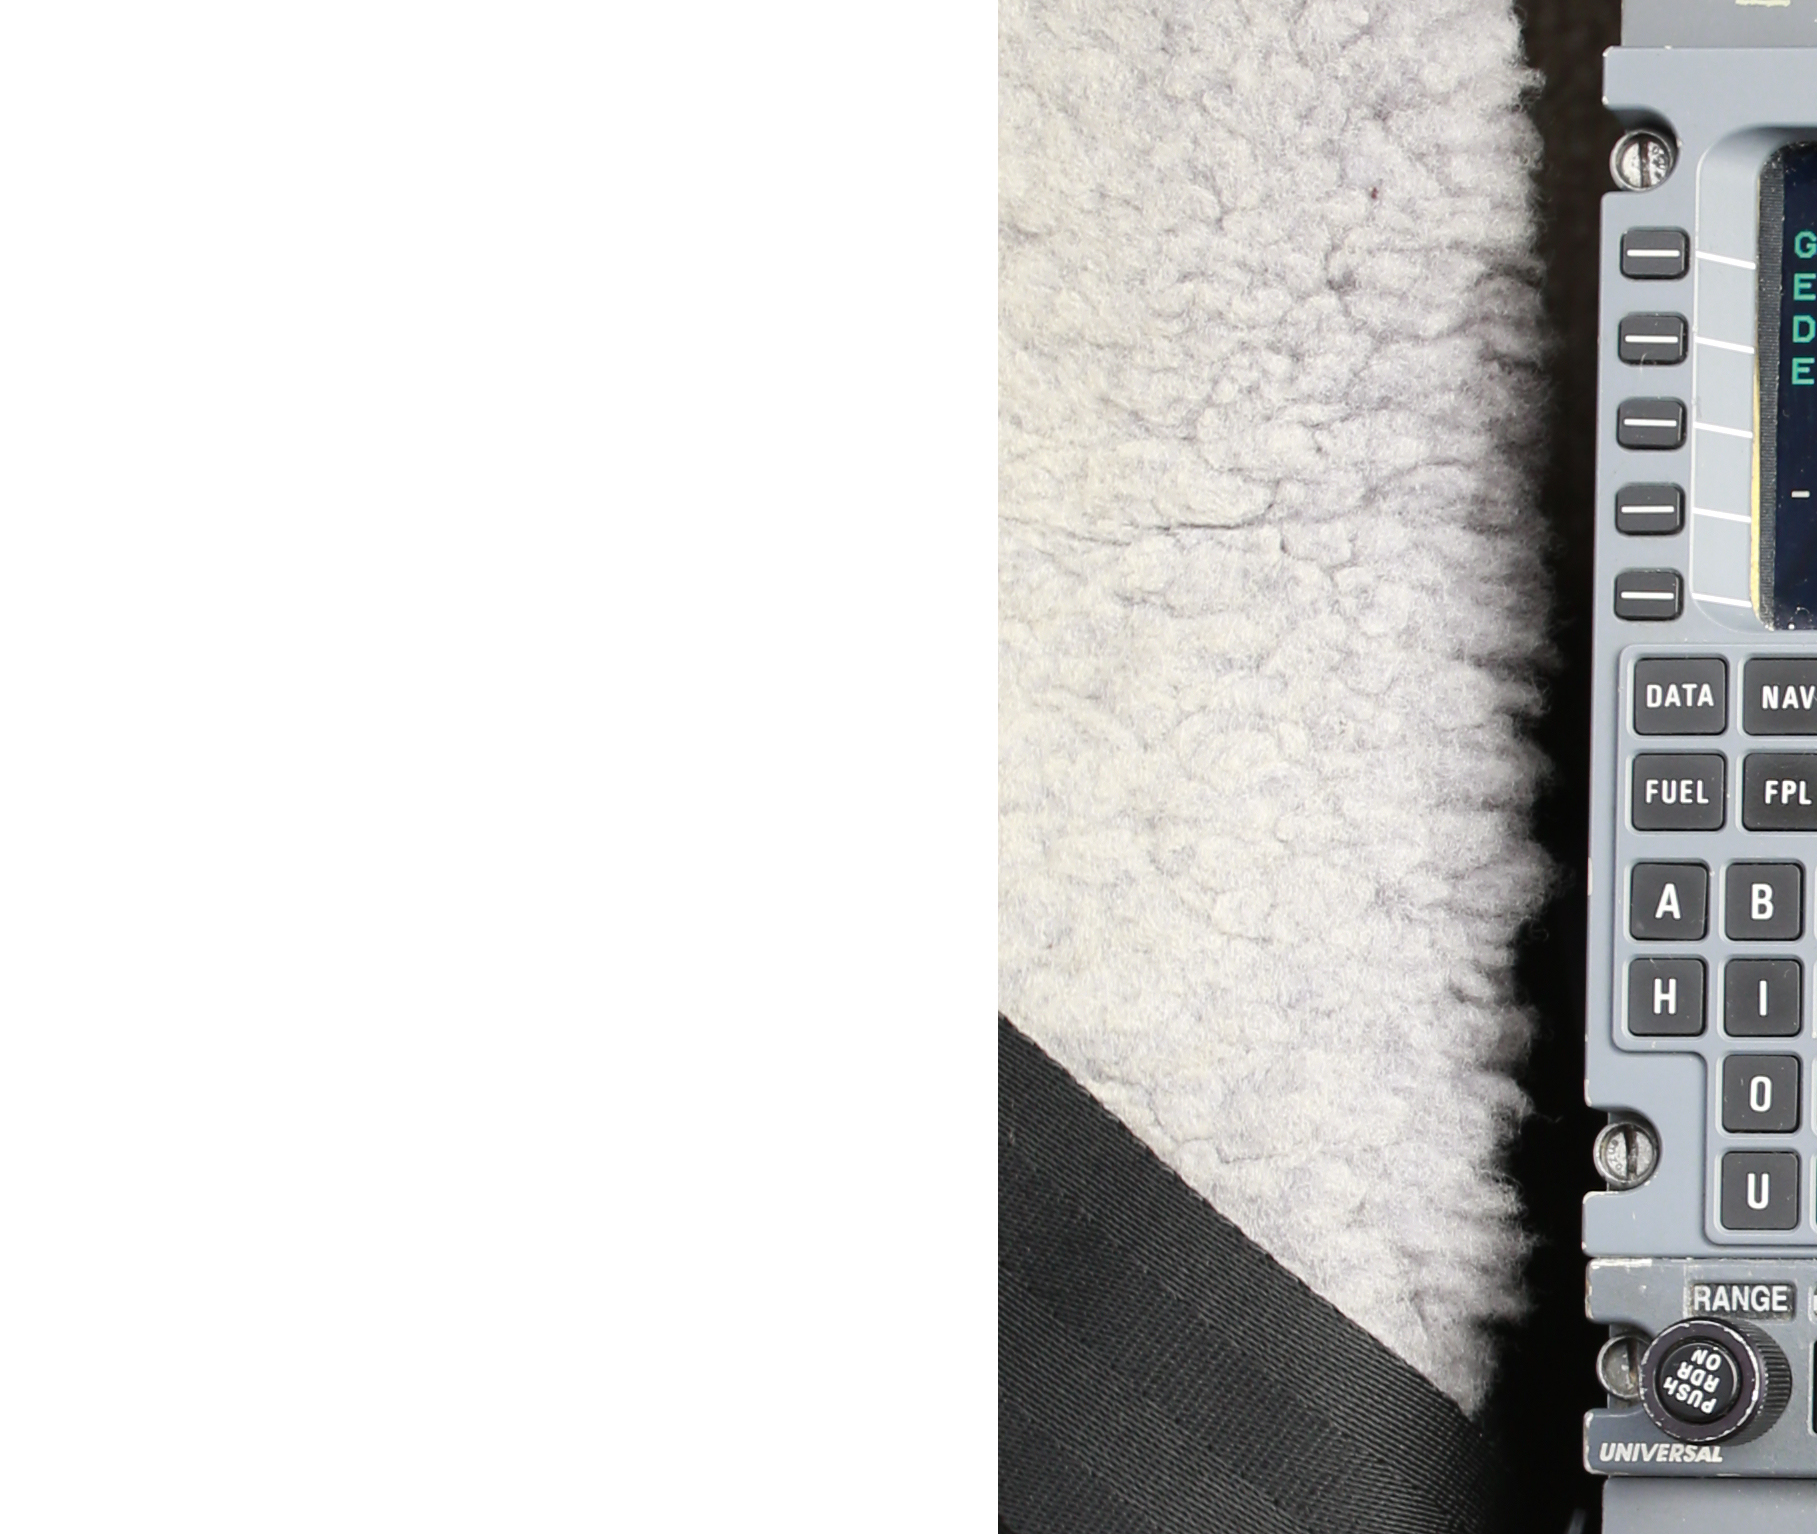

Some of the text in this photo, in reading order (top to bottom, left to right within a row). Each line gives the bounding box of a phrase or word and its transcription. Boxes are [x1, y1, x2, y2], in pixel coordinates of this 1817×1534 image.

[1647, 684, 1713, 707] DATA
[1646, 780, 1708, 803] FUEL
[1693, 1285, 1789, 1313] RANGE
[1600, 1443, 1723, 1462] UNIVERSAL
